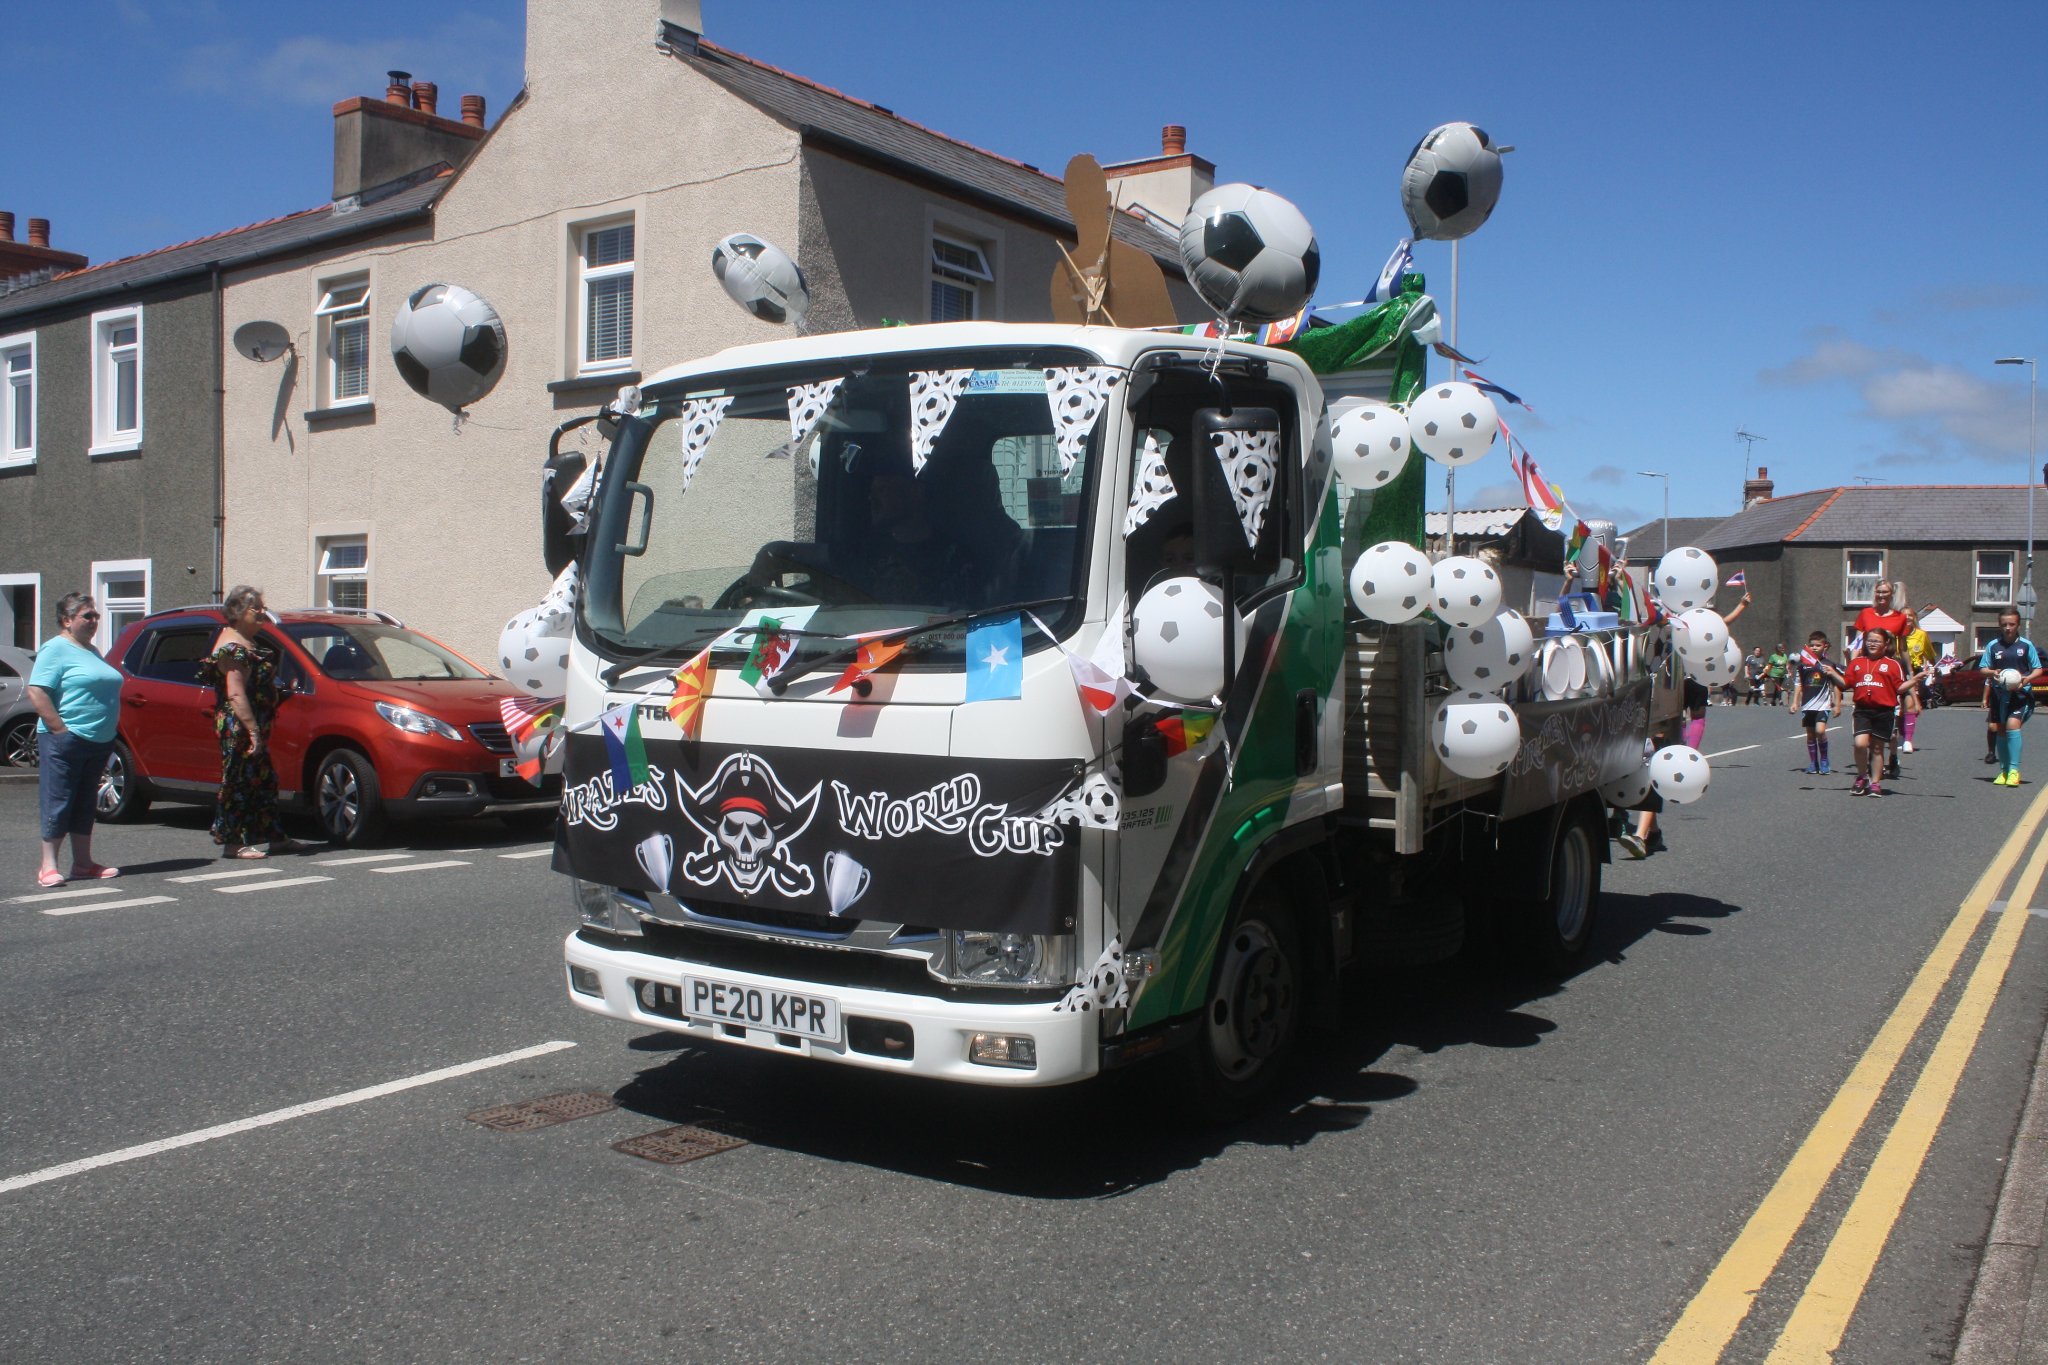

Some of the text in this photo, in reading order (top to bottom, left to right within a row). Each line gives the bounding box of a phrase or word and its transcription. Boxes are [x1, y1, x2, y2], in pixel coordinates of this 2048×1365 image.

[562, 765, 668, 832] IRATS
[693, 980, 826, 1034] PE20 KPR
